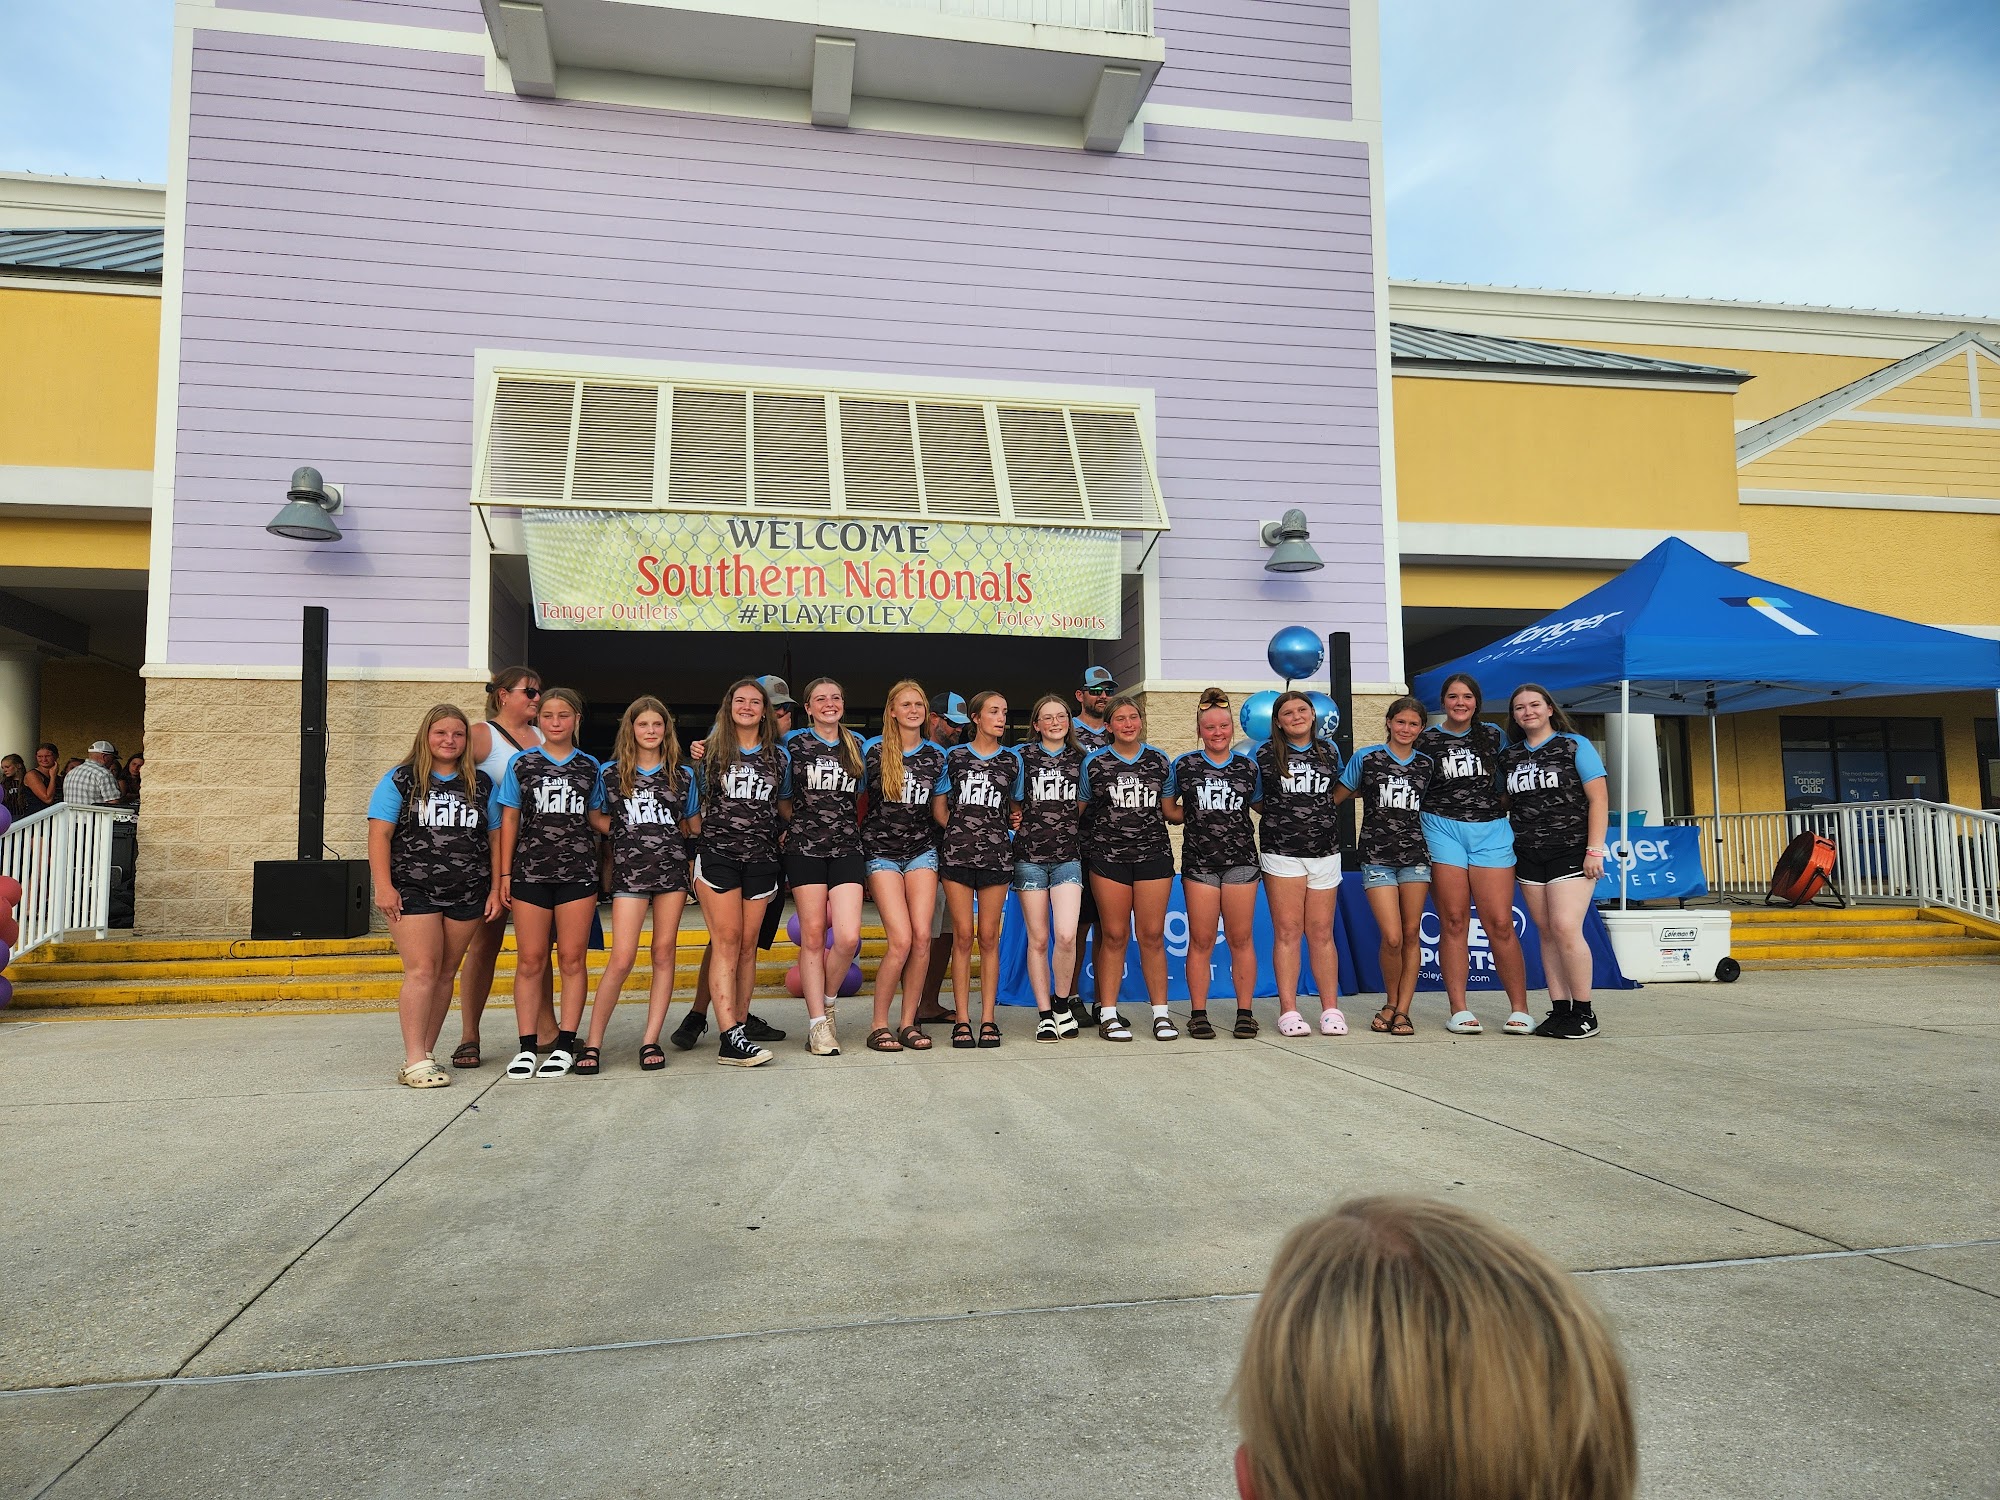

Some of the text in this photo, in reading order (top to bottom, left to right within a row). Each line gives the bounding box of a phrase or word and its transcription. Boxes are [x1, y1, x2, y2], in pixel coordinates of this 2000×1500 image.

[726, 519, 930, 554] WELCOME
[636, 553, 1033, 604] Southern Nationals
[539, 601, 679, 623] Tanger Outlets
[737, 603, 914, 626] #PLAYFOLEY
[996, 610, 1106, 631] Foley Sports
[1502, 610, 1625, 648] Tanger
[1477, 637, 1576, 664] OUTLETS
[806, 764, 857, 793] Mafia
[1441, 753, 1491, 780] Mafi
[723, 773, 774, 801] Mafia
[959, 779, 1002, 809] Mafia
[1031, 776, 1077, 801] Mafia
[1280, 769, 1331, 794] Mafia
[1507, 767, 1559, 795] Mafia
[1793, 776, 1825, 786] Tanger
[1801, 784, 1822, 794] Club
[533, 785, 585, 815] Mafia
[1108, 783, 1158, 808] Mafia
[1196, 785, 1244, 811] Mafia
[418, 798, 479, 829] Mafia
[623, 797, 676, 826] Mafia
[1664, 929, 1689, 938] Coleman
